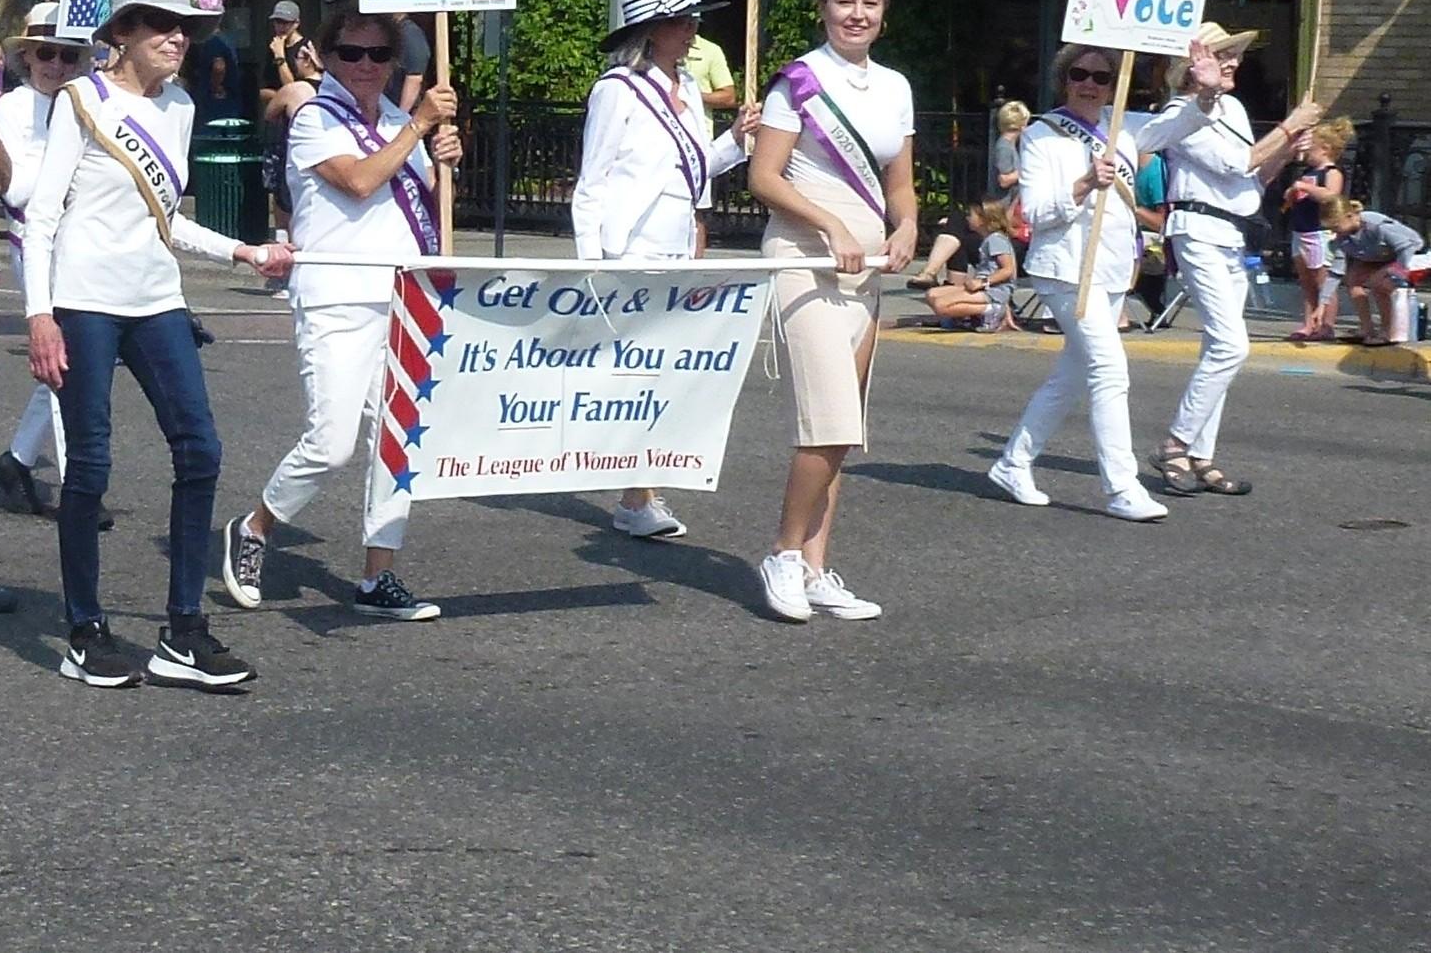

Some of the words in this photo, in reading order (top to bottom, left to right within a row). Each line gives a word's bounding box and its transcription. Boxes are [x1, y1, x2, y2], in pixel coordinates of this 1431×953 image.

[115, 125, 165, 187] VOTES
[831, 126, 855, 153] 1920
[477, 276, 540, 308] Get
[548, 286, 617, 317] Out
[622, 287, 650, 313] &
[666, 283, 756, 314] VOTE
[458, 340, 496, 373] It's
[505, 337, 602, 370] About
[612, 339, 663, 371] You
[674, 341, 739, 372] and
[498, 393, 561, 424] Your
[570, 391, 669, 431] Family
[436, 457, 469, 478] The
[476, 454, 543, 479] League
[550, 451, 570, 470] of
[574, 450, 638, 470] Women
[645, 449, 703, 470] Voters
